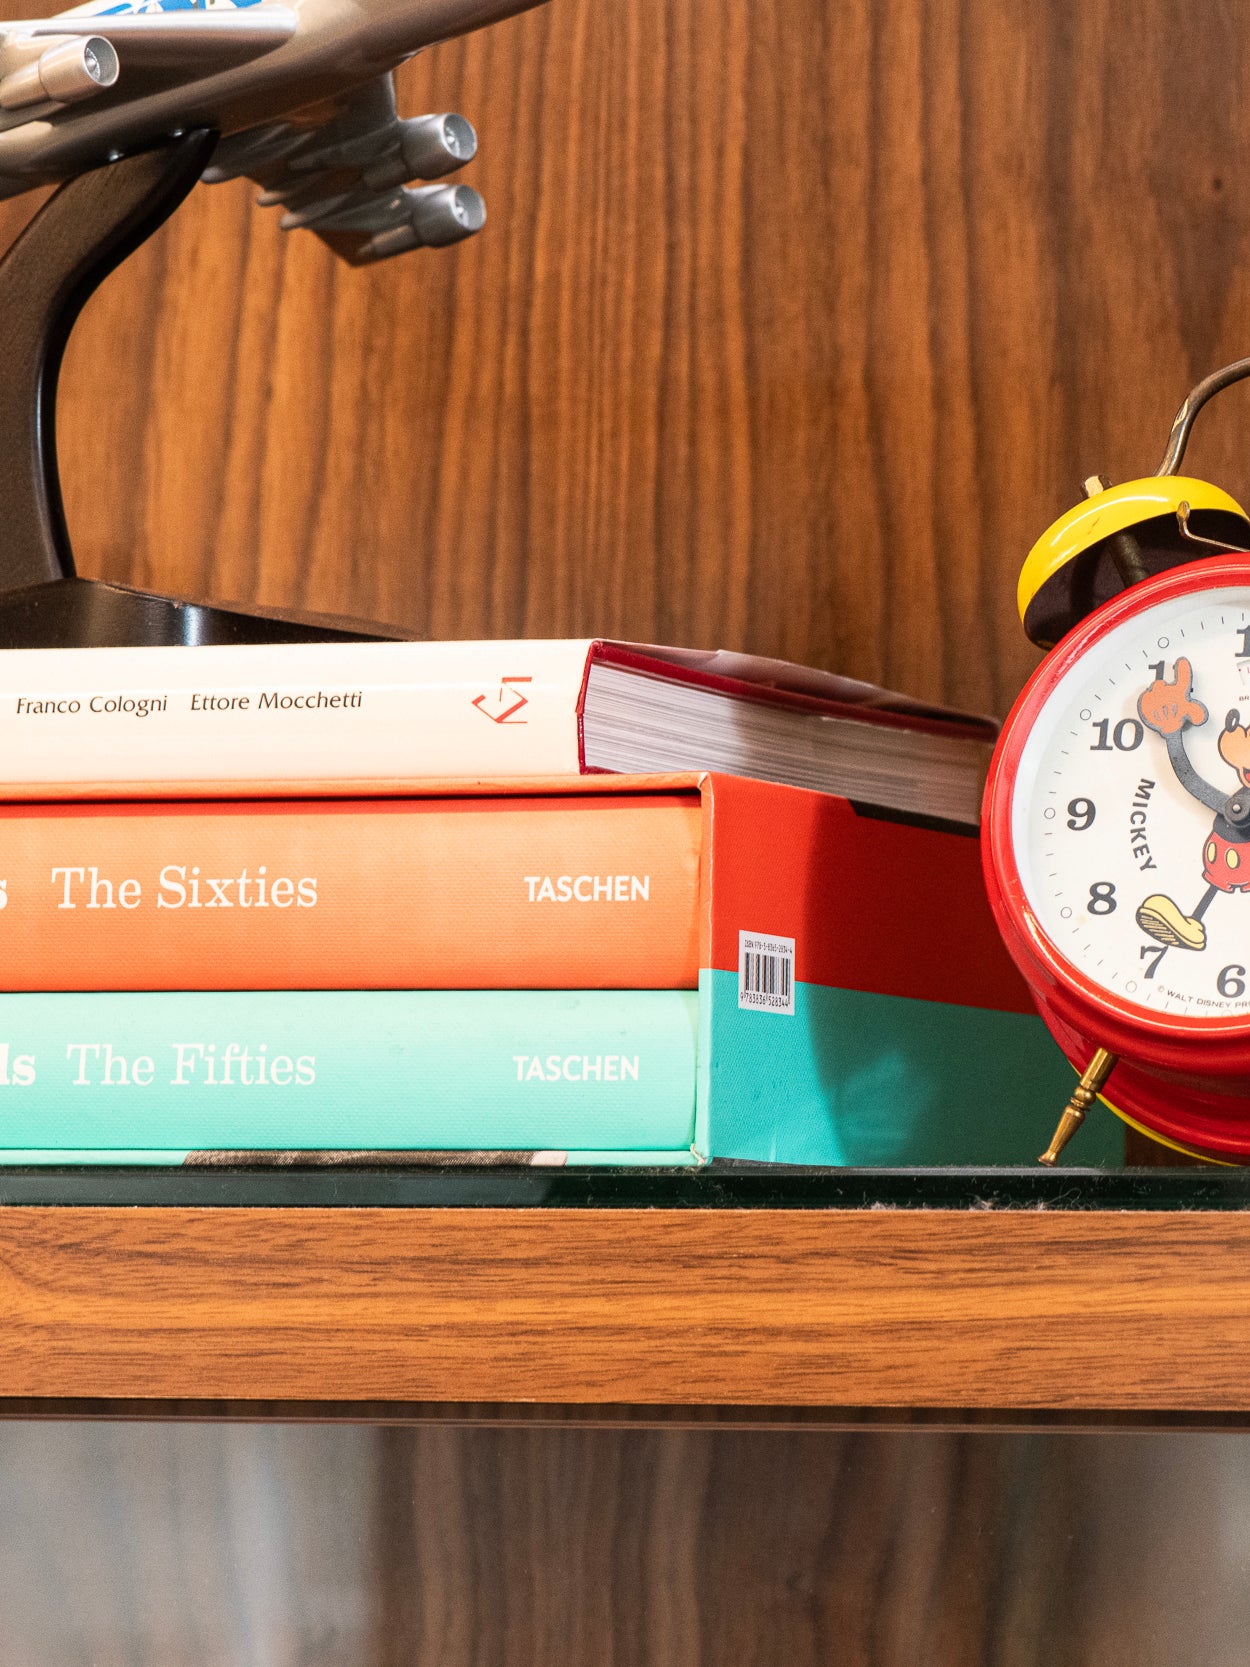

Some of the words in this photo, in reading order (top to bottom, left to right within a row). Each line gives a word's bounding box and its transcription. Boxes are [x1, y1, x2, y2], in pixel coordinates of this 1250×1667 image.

[16, 697, 81, 714] Franco
[89, 695, 168, 718] Cologni
[190, 693, 250, 711] Ettore
[257, 690, 363, 709] Mocchetti
[1089, 717, 1145, 752] 10
[1066, 797, 1097, 831] 9
[1129, 778, 1157, 871] MICKEY
[51, 866, 142, 909] The
[156, 864, 319, 909] Sixties
[523, 874, 650, 903] TASCHEN
[1087, 881, 1118, 916] 8
[1140, 945, 1169, 980] 7
[1166, 989, 1194, 1002] WALT
[1196, 998, 1231, 1009] DISNEY
[1216, 964, 1247, 999] 6
[66, 1043, 155, 1086] The
[169, 1043, 317, 1086] Fifties
[512, 1055, 640, 1082] TASCHEN
